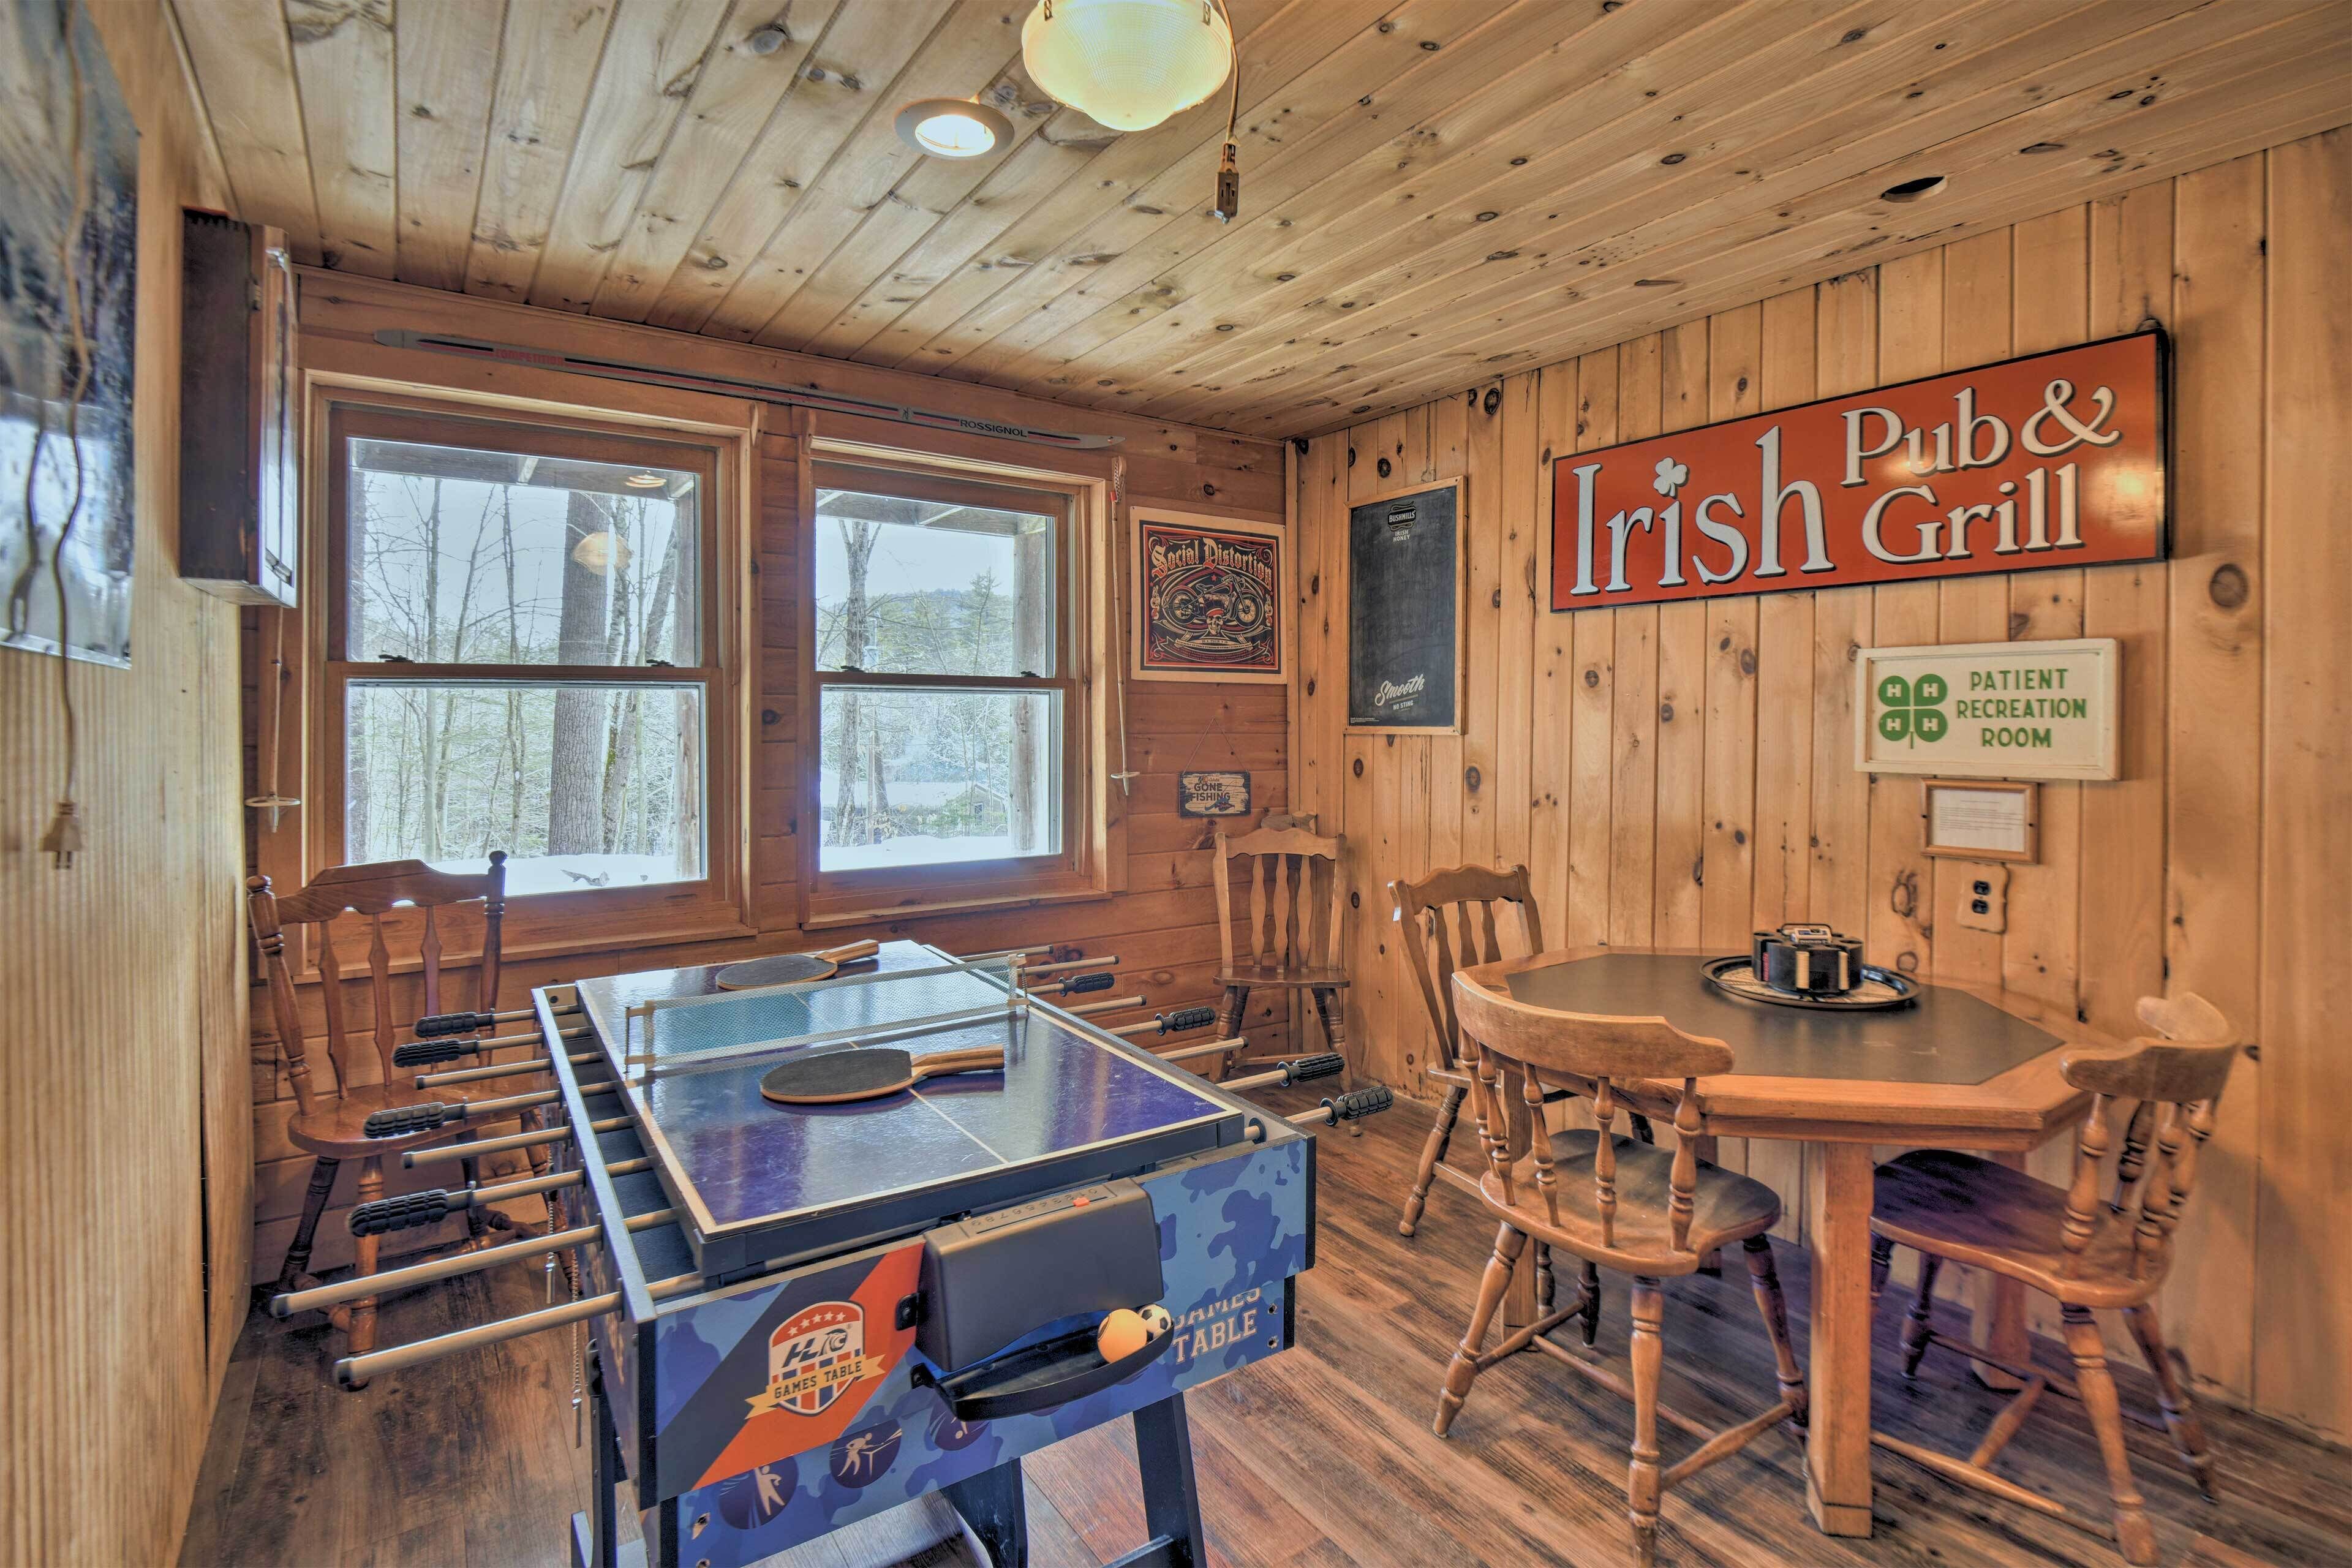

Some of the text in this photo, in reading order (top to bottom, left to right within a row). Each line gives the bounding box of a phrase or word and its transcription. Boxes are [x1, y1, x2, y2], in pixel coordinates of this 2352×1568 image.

[960, 419, 1027, 437] ROSSIGNOL
[1839, 379, 2120, 488] Pub &
[1571, 426, 1836, 597] Irish
[1861, 462, 2086, 566] Grill
[1152, 537, 1272, 592] Social Distortion
[1374, 674, 1425, 706] Smooth
[1970, 668, 2068, 690] PATIENT
[1400, 700, 1414, 709] STING
[1957, 698, 2086, 718] RECREATION
[1982, 727, 2051, 748] ROOM
[1191, 793, 1231, 801] FISHING
[1194, 783, 1223, 791] GONE
[1172, 1308, 1258, 1365] TABLE
[774, 1361, 862, 1399] GAMES TABLE
